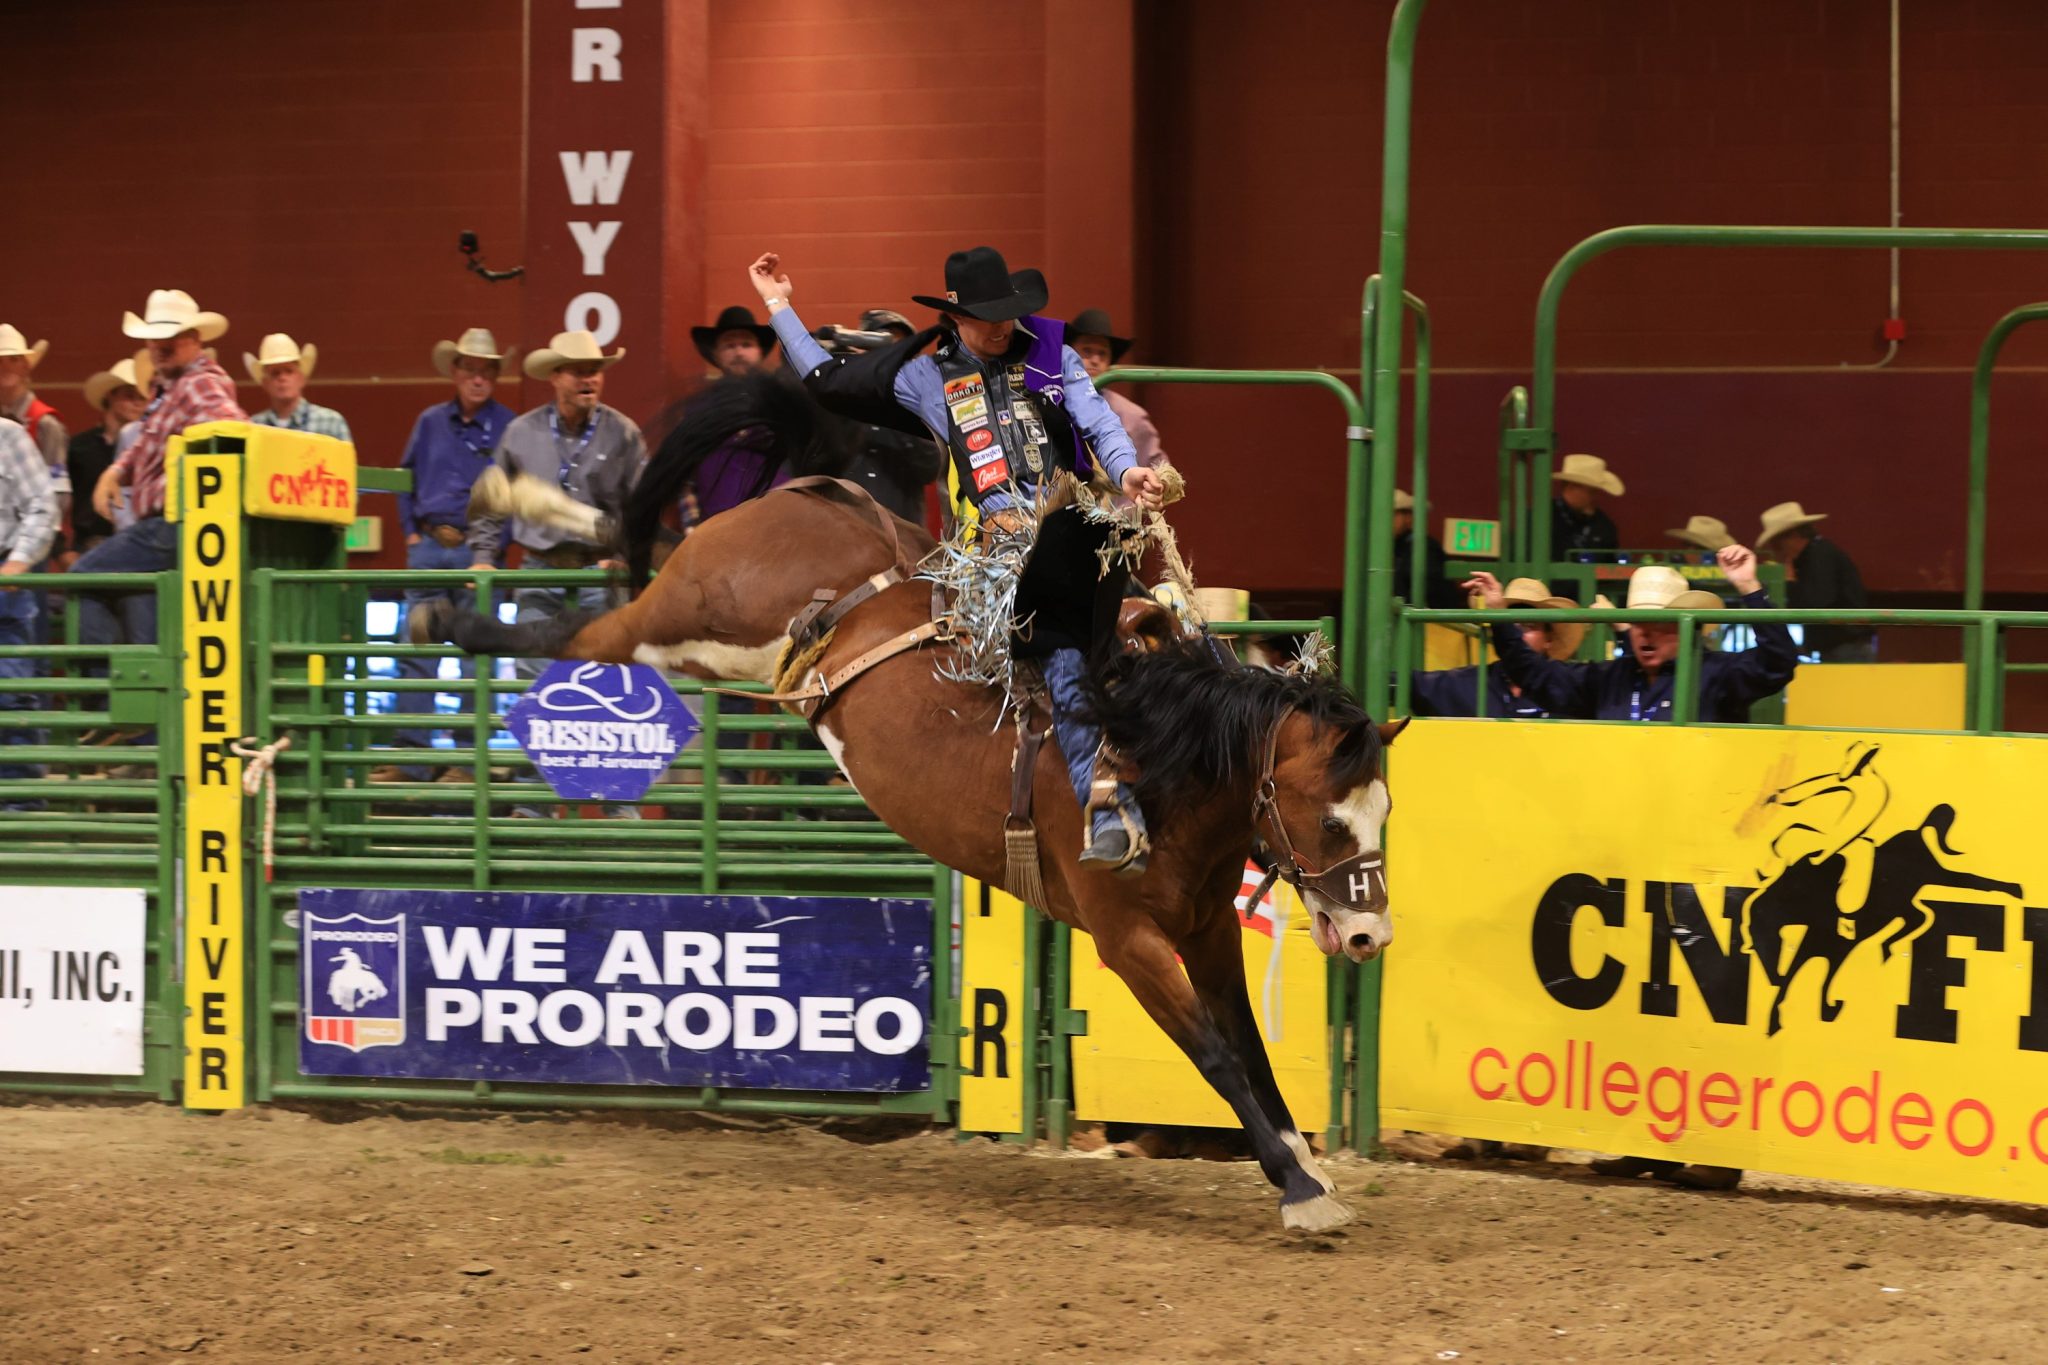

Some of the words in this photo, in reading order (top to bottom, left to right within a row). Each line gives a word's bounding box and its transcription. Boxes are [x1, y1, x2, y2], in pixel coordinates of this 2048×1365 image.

[572, 0, 623, 83] R
[559, 150, 633, 347] WYO
[1455, 521, 1495, 552] EXIT
[192, 466, 231, 785] POWDER
[527, 719, 676, 753] RESISTOL
[539, 752, 577, 767] best
[578, 753, 663, 769] all-around
[52, 950, 133, 1003] INC.
[199, 830, 228, 1091] RIVER
[422, 926, 567, 983] WE
[594, 930, 780, 987] ARE
[425, 988, 924, 1056] PRORODEO
